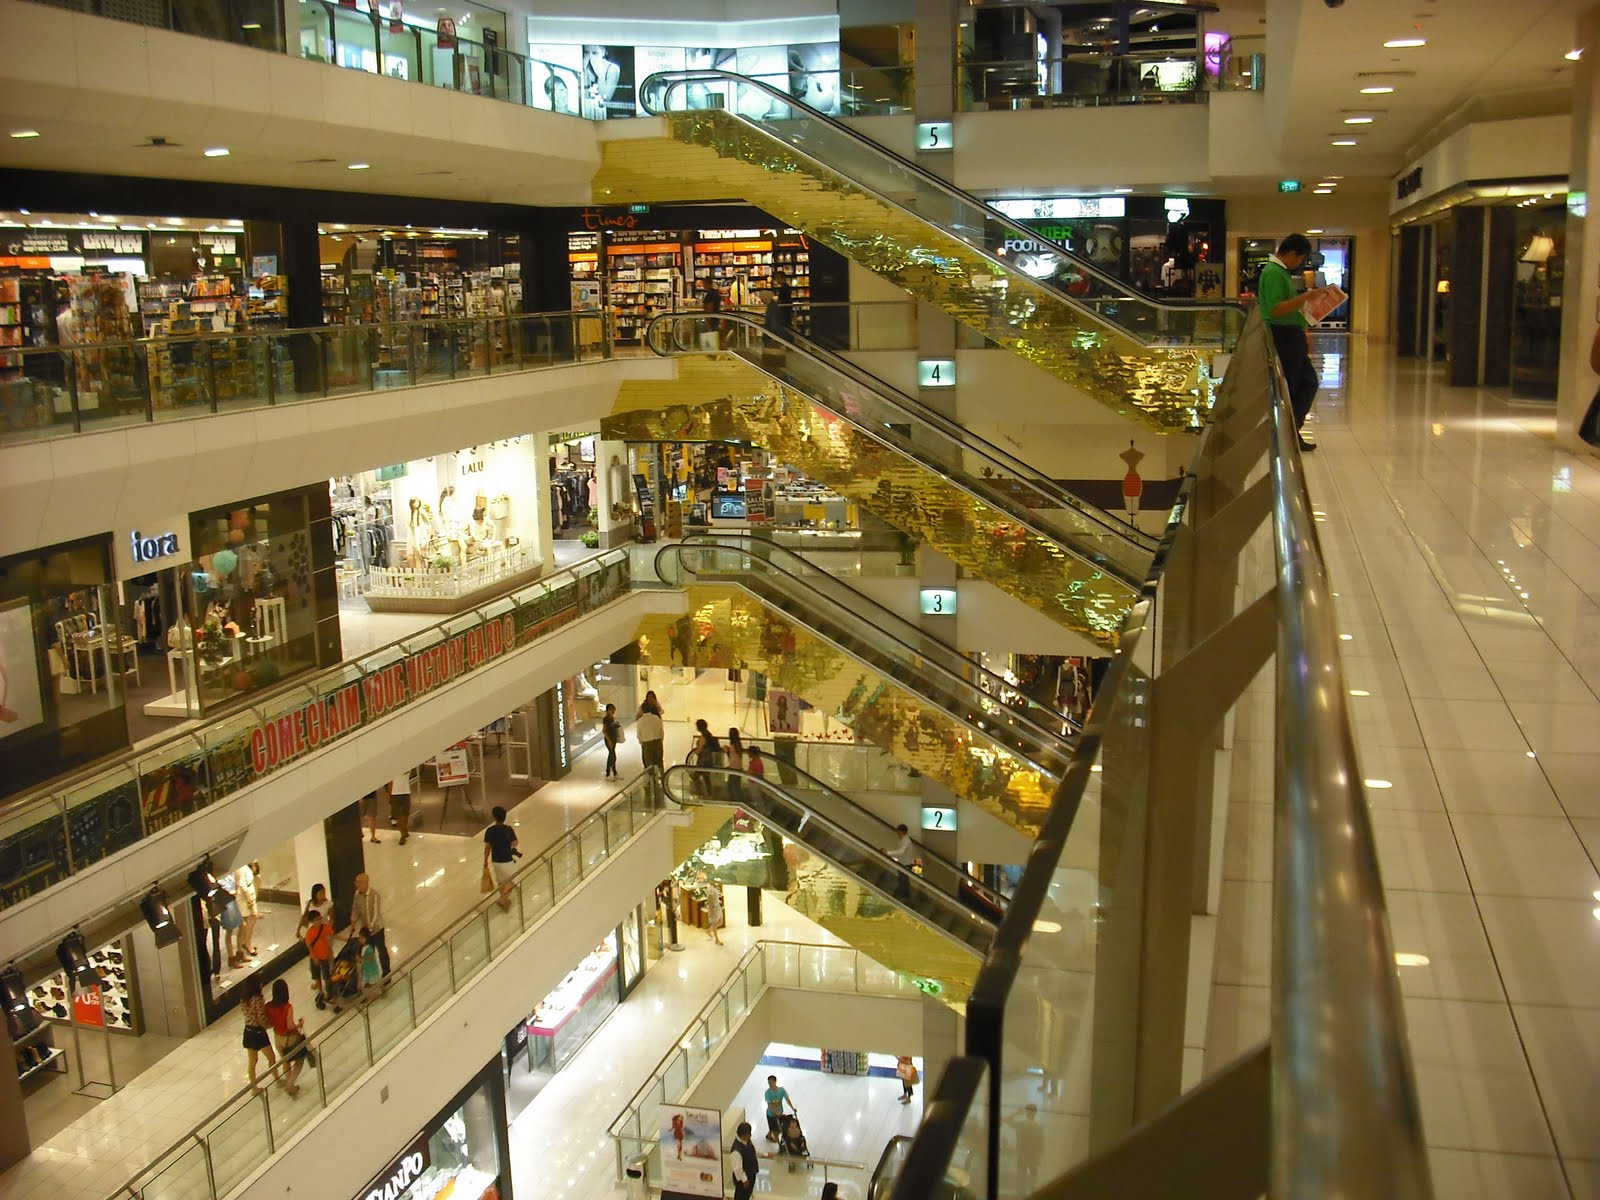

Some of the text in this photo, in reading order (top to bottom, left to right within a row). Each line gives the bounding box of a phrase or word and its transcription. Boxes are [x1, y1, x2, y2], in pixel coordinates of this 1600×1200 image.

[930, 127, 938, 146] 5
[1284, 182, 1299, 191] EXIT
[581, 208, 638, 230] times
[1004, 239, 1074, 252] FOOTL
[932, 364, 940, 383] 4
[461, 461, 484, 475] LALU
[131, 530, 180, 562] iora
[934, 594, 942, 612] 3
[251, 709, 306, 775] COME
[306, 682, 361, 747] CLAIM
[362, 663, 405, 717] YOUR
[405, 634, 465, 696] VICTORY
[934, 811, 943, 828] 2
